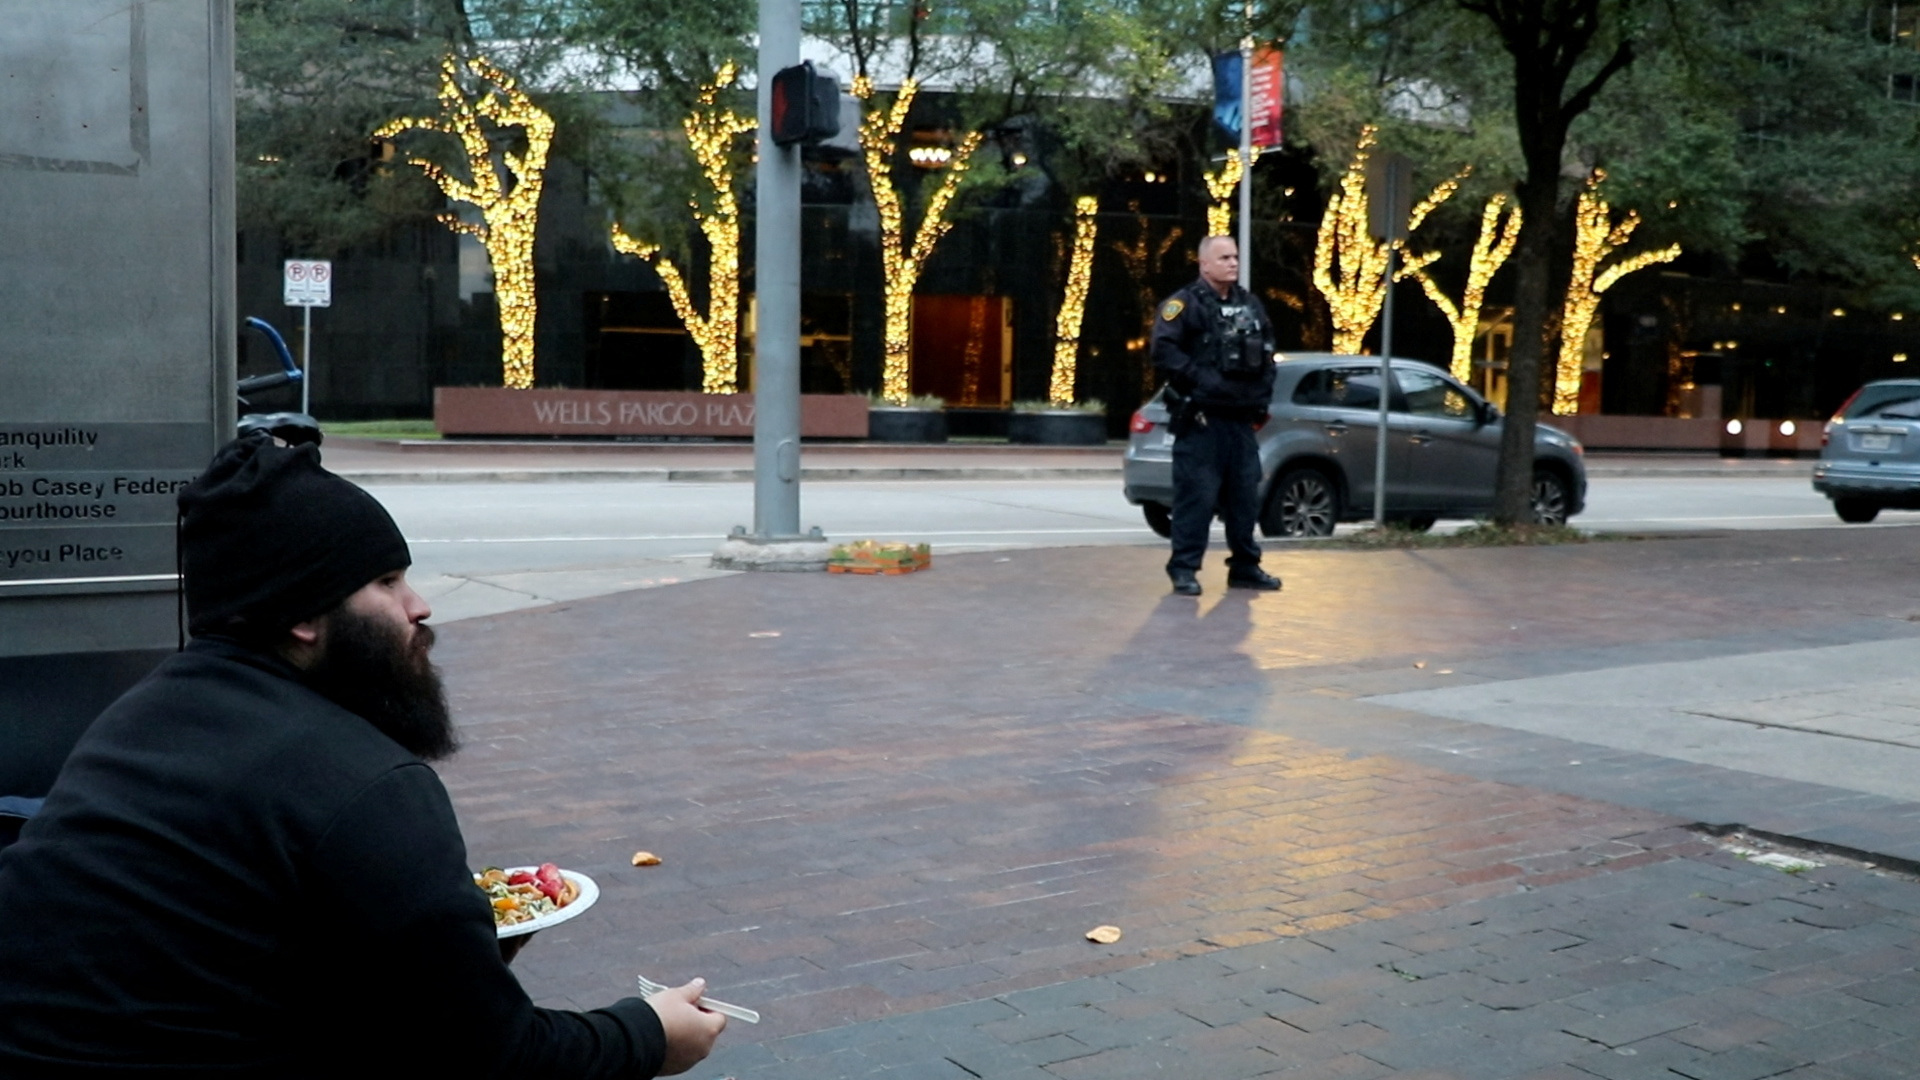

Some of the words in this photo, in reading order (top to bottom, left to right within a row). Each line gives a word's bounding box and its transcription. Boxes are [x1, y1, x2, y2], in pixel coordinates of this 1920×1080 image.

[533, 401, 611, 425] WELLS
[620, 402, 697, 425] FARGO
[706, 404, 756, 426] PLAZ
[0, 452, 26, 468] rk
[32, 478, 104, 499] Casey
[114, 476, 196, 494] Federa
[59, 544, 124, 562] Place
